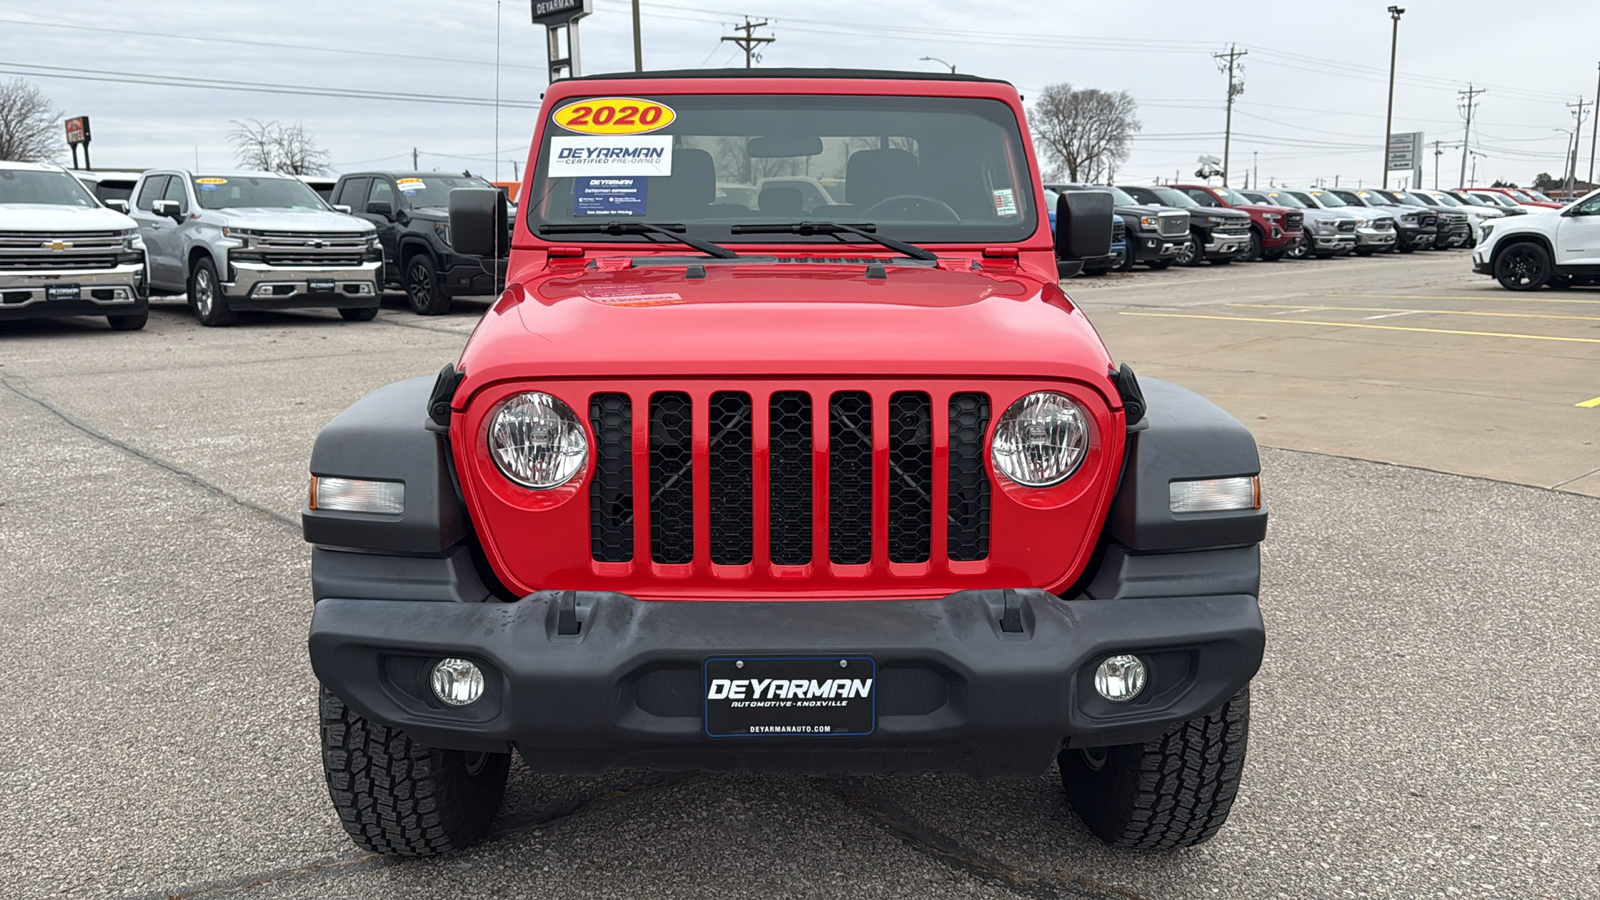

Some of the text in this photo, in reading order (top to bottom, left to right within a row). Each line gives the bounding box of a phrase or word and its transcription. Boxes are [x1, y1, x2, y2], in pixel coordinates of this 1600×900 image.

[536, 0, 575, 14] DEYARMAN
[566, 106, 663, 126] 2020
[557, 147, 665, 159] DEYARMAN
[707, 678, 873, 699] DEYARMAN
[750, 725, 831, 733] DEYARMANAUTO.COM
